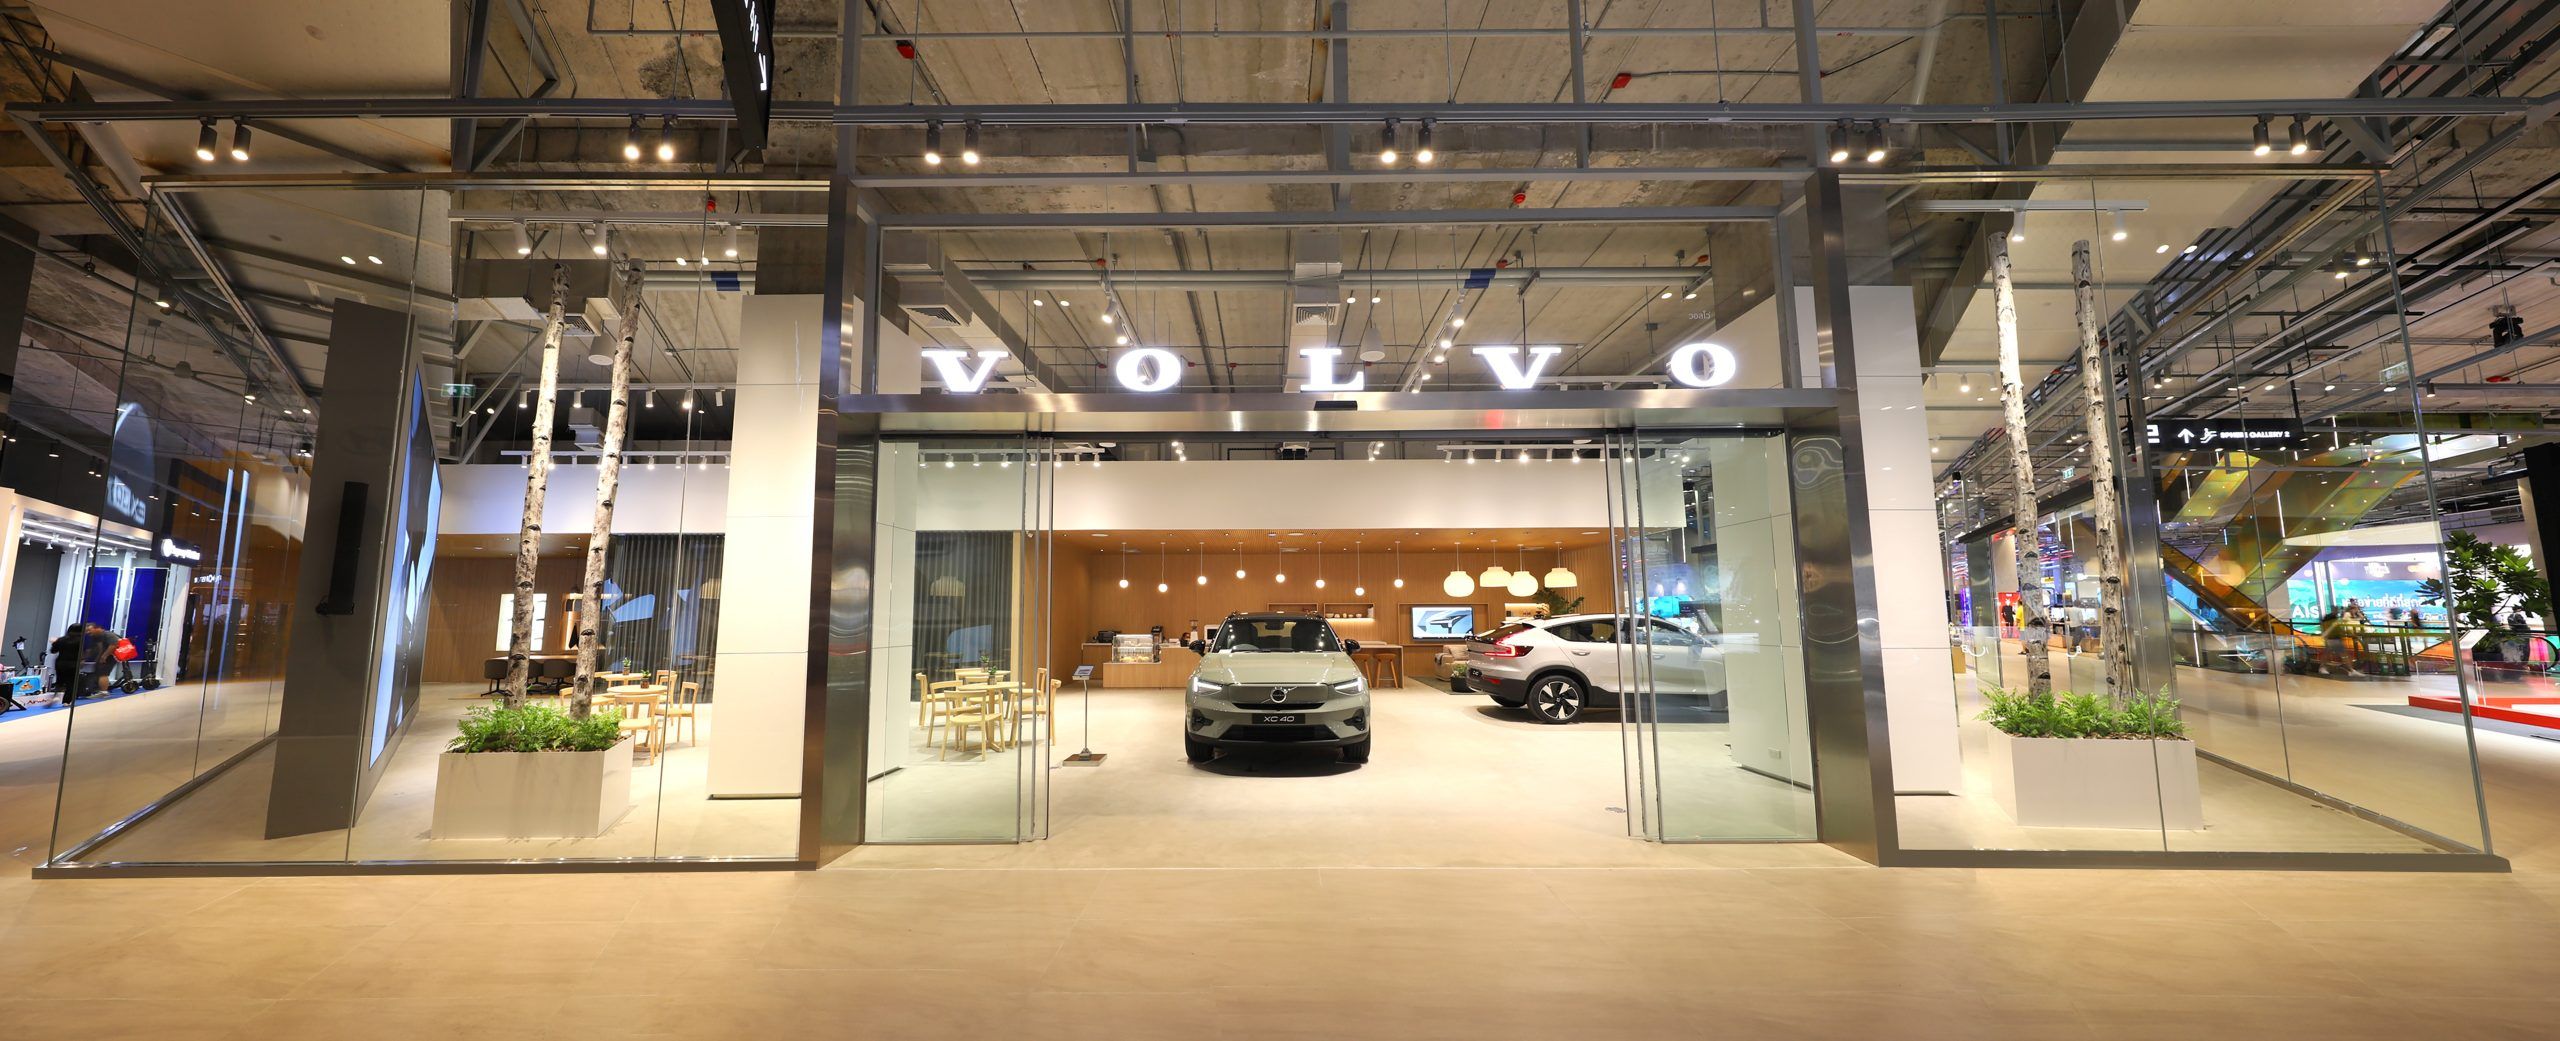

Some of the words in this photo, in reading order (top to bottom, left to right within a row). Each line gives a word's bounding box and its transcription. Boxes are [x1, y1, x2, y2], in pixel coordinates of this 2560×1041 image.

[920, 342, 1737, 393] VOLVO
[2249, 431, 2283, 439] GALLERY
[2292, 605, 2320, 619] AIS
[1263, 715, 1279, 723] XC
[1280, 715, 1295, 723] 40
